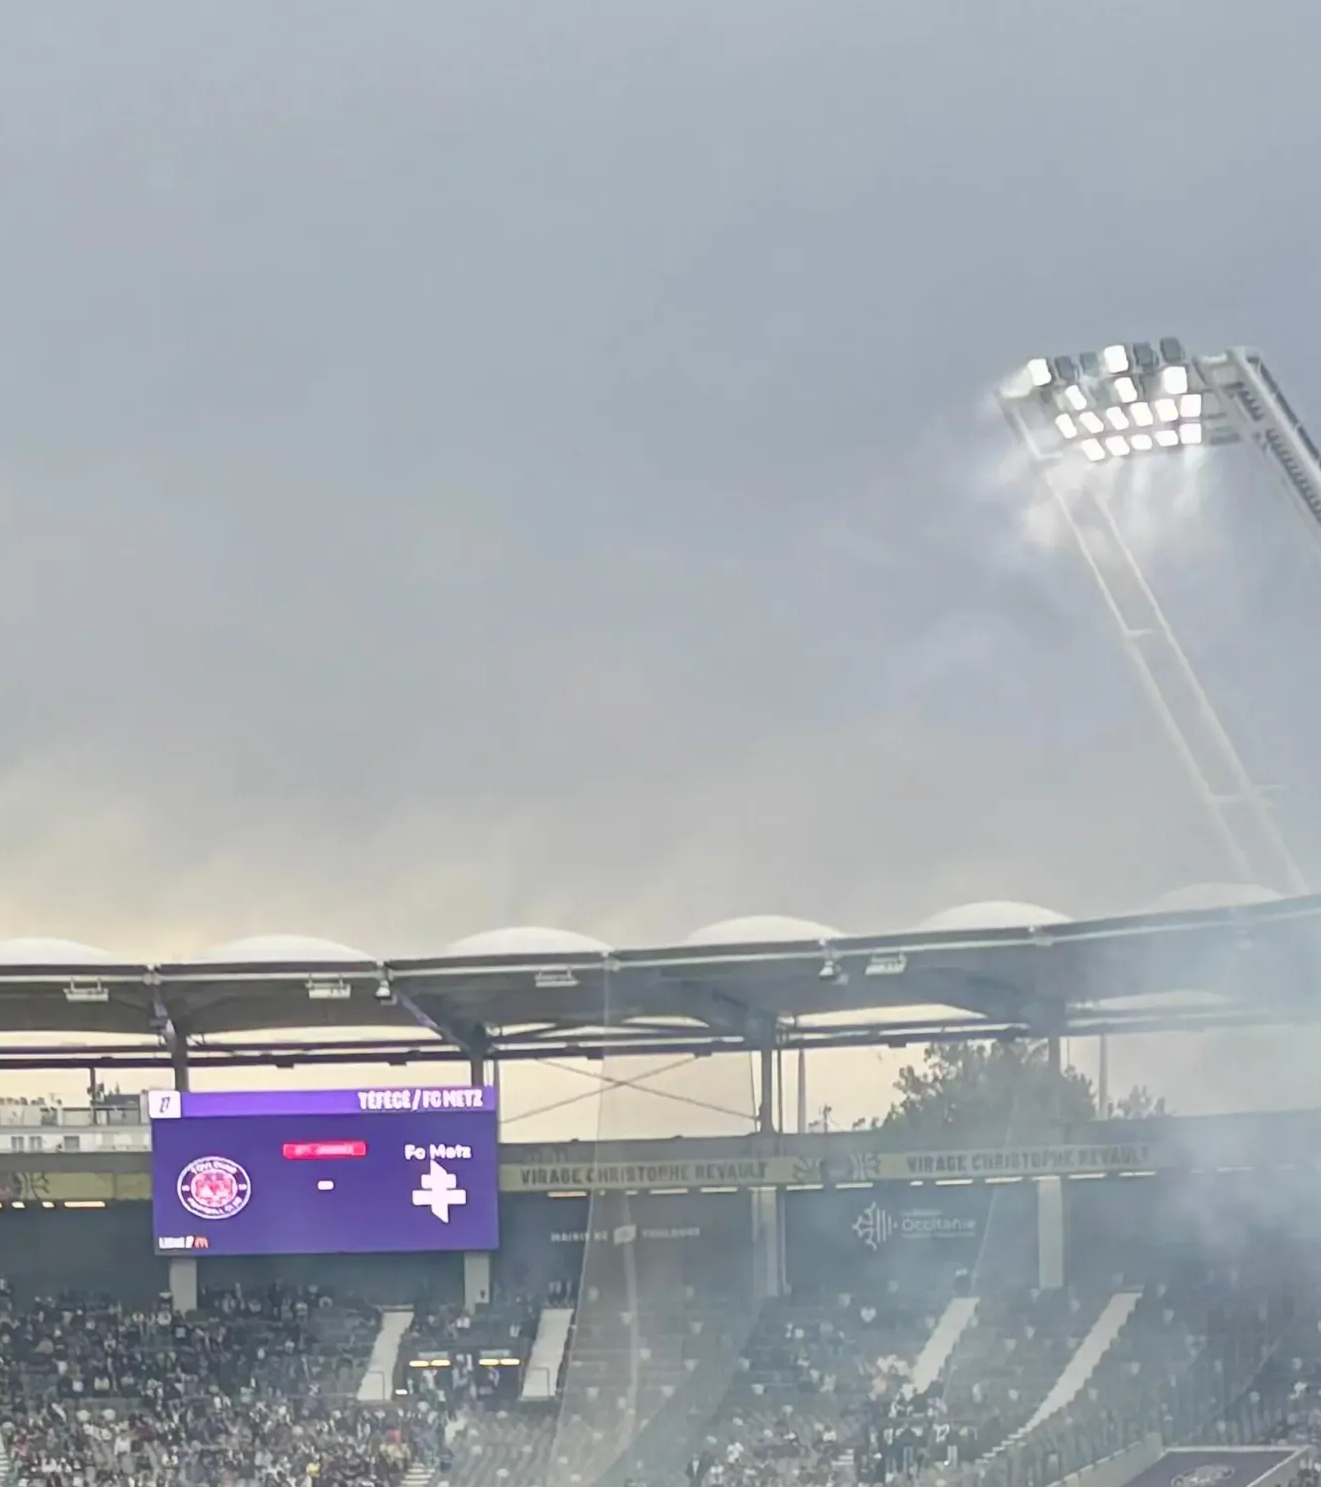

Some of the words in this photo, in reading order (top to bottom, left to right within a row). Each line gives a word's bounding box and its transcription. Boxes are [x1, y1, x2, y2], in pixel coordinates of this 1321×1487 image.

[442, 1089, 483, 1108] METZ
[429, 1144, 472, 1159] Metz
[906, 1155, 966, 1173] VIRAGE
[520, 1167, 581, 1186] VIRAGE
[585, 1164, 688, 1184] CHRISTOPHE
[694, 1161, 766, 1180] REVAULT
[902, 1217, 976, 1232] Occitanie
